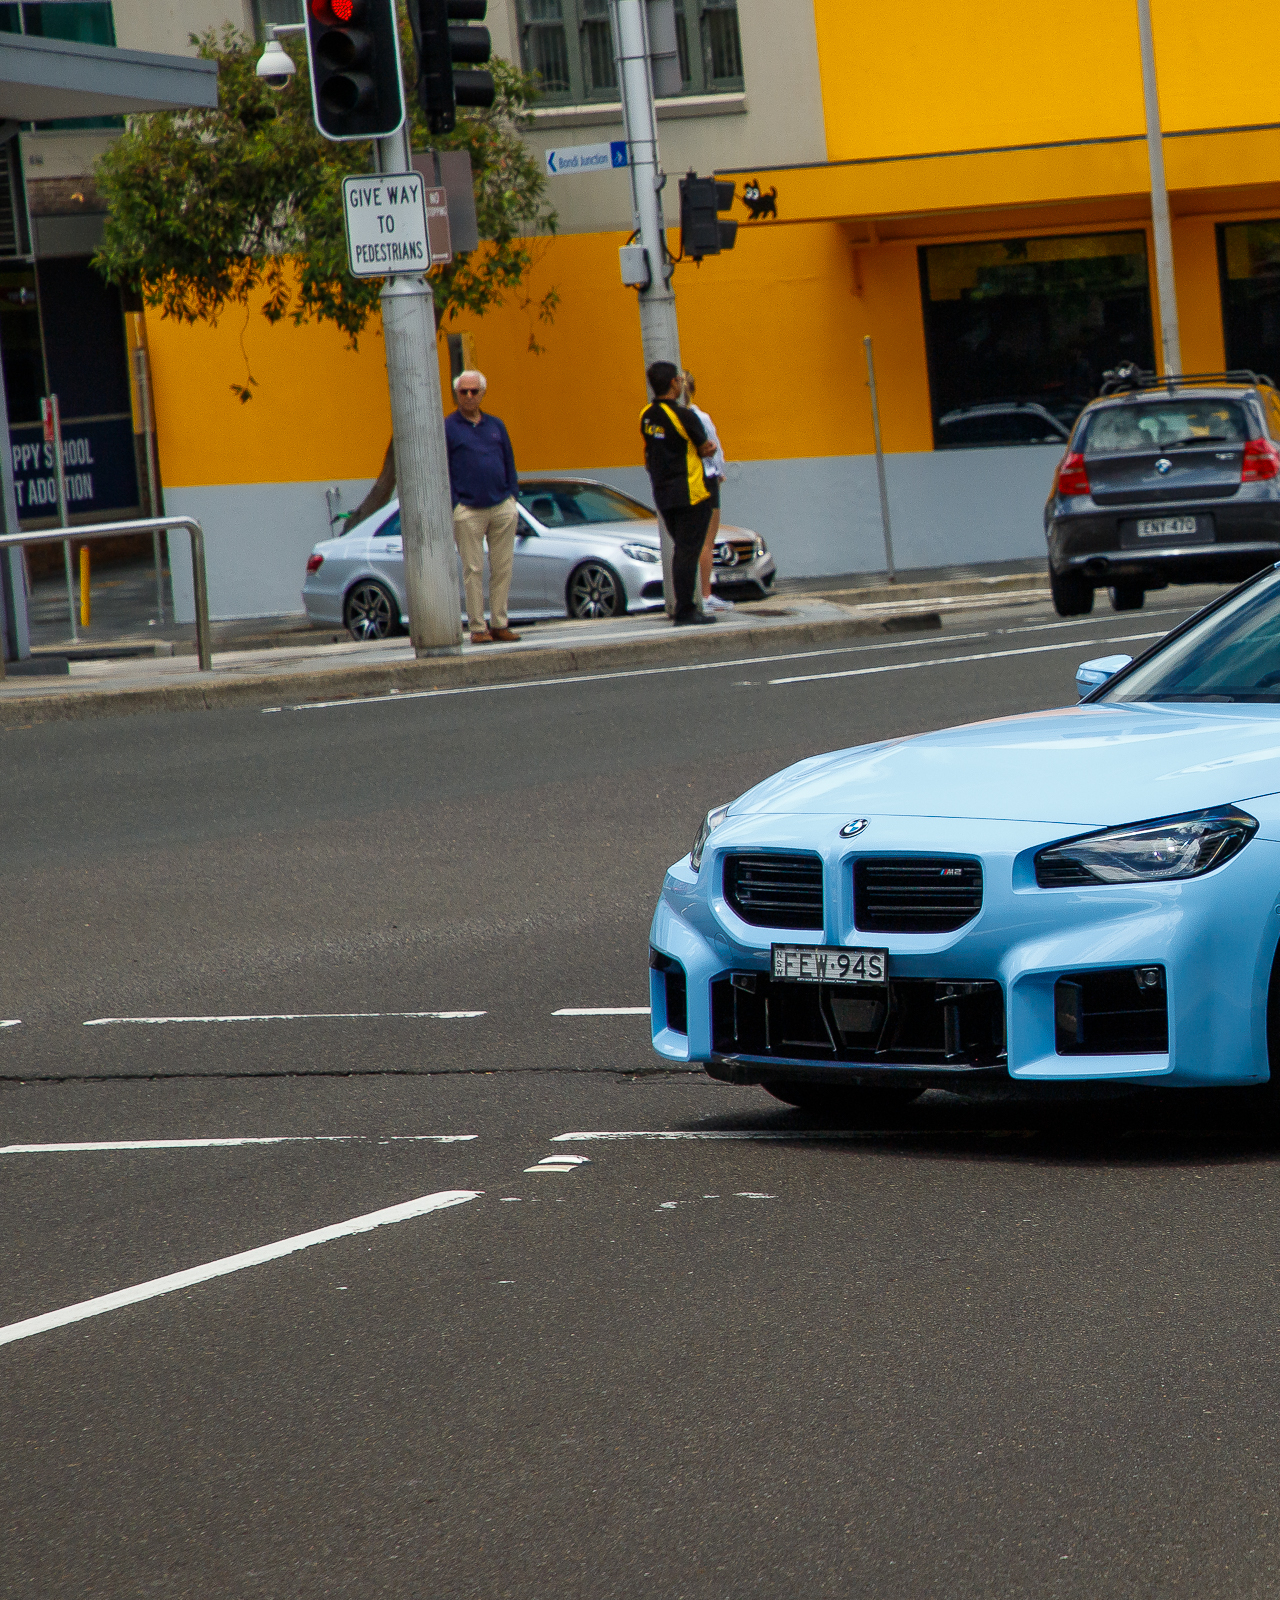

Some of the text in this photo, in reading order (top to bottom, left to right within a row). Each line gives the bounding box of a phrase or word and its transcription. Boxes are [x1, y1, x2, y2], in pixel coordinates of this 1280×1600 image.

[558, 152, 609, 169] Bondi Junction
[350, 184, 418, 208] GIVE WAY
[377, 214, 395, 234] TO
[355, 241, 424, 263] PEDESTRIANS
[43, 437, 94, 469] SHOOL
[28, 472, 94, 506] ADOTION
